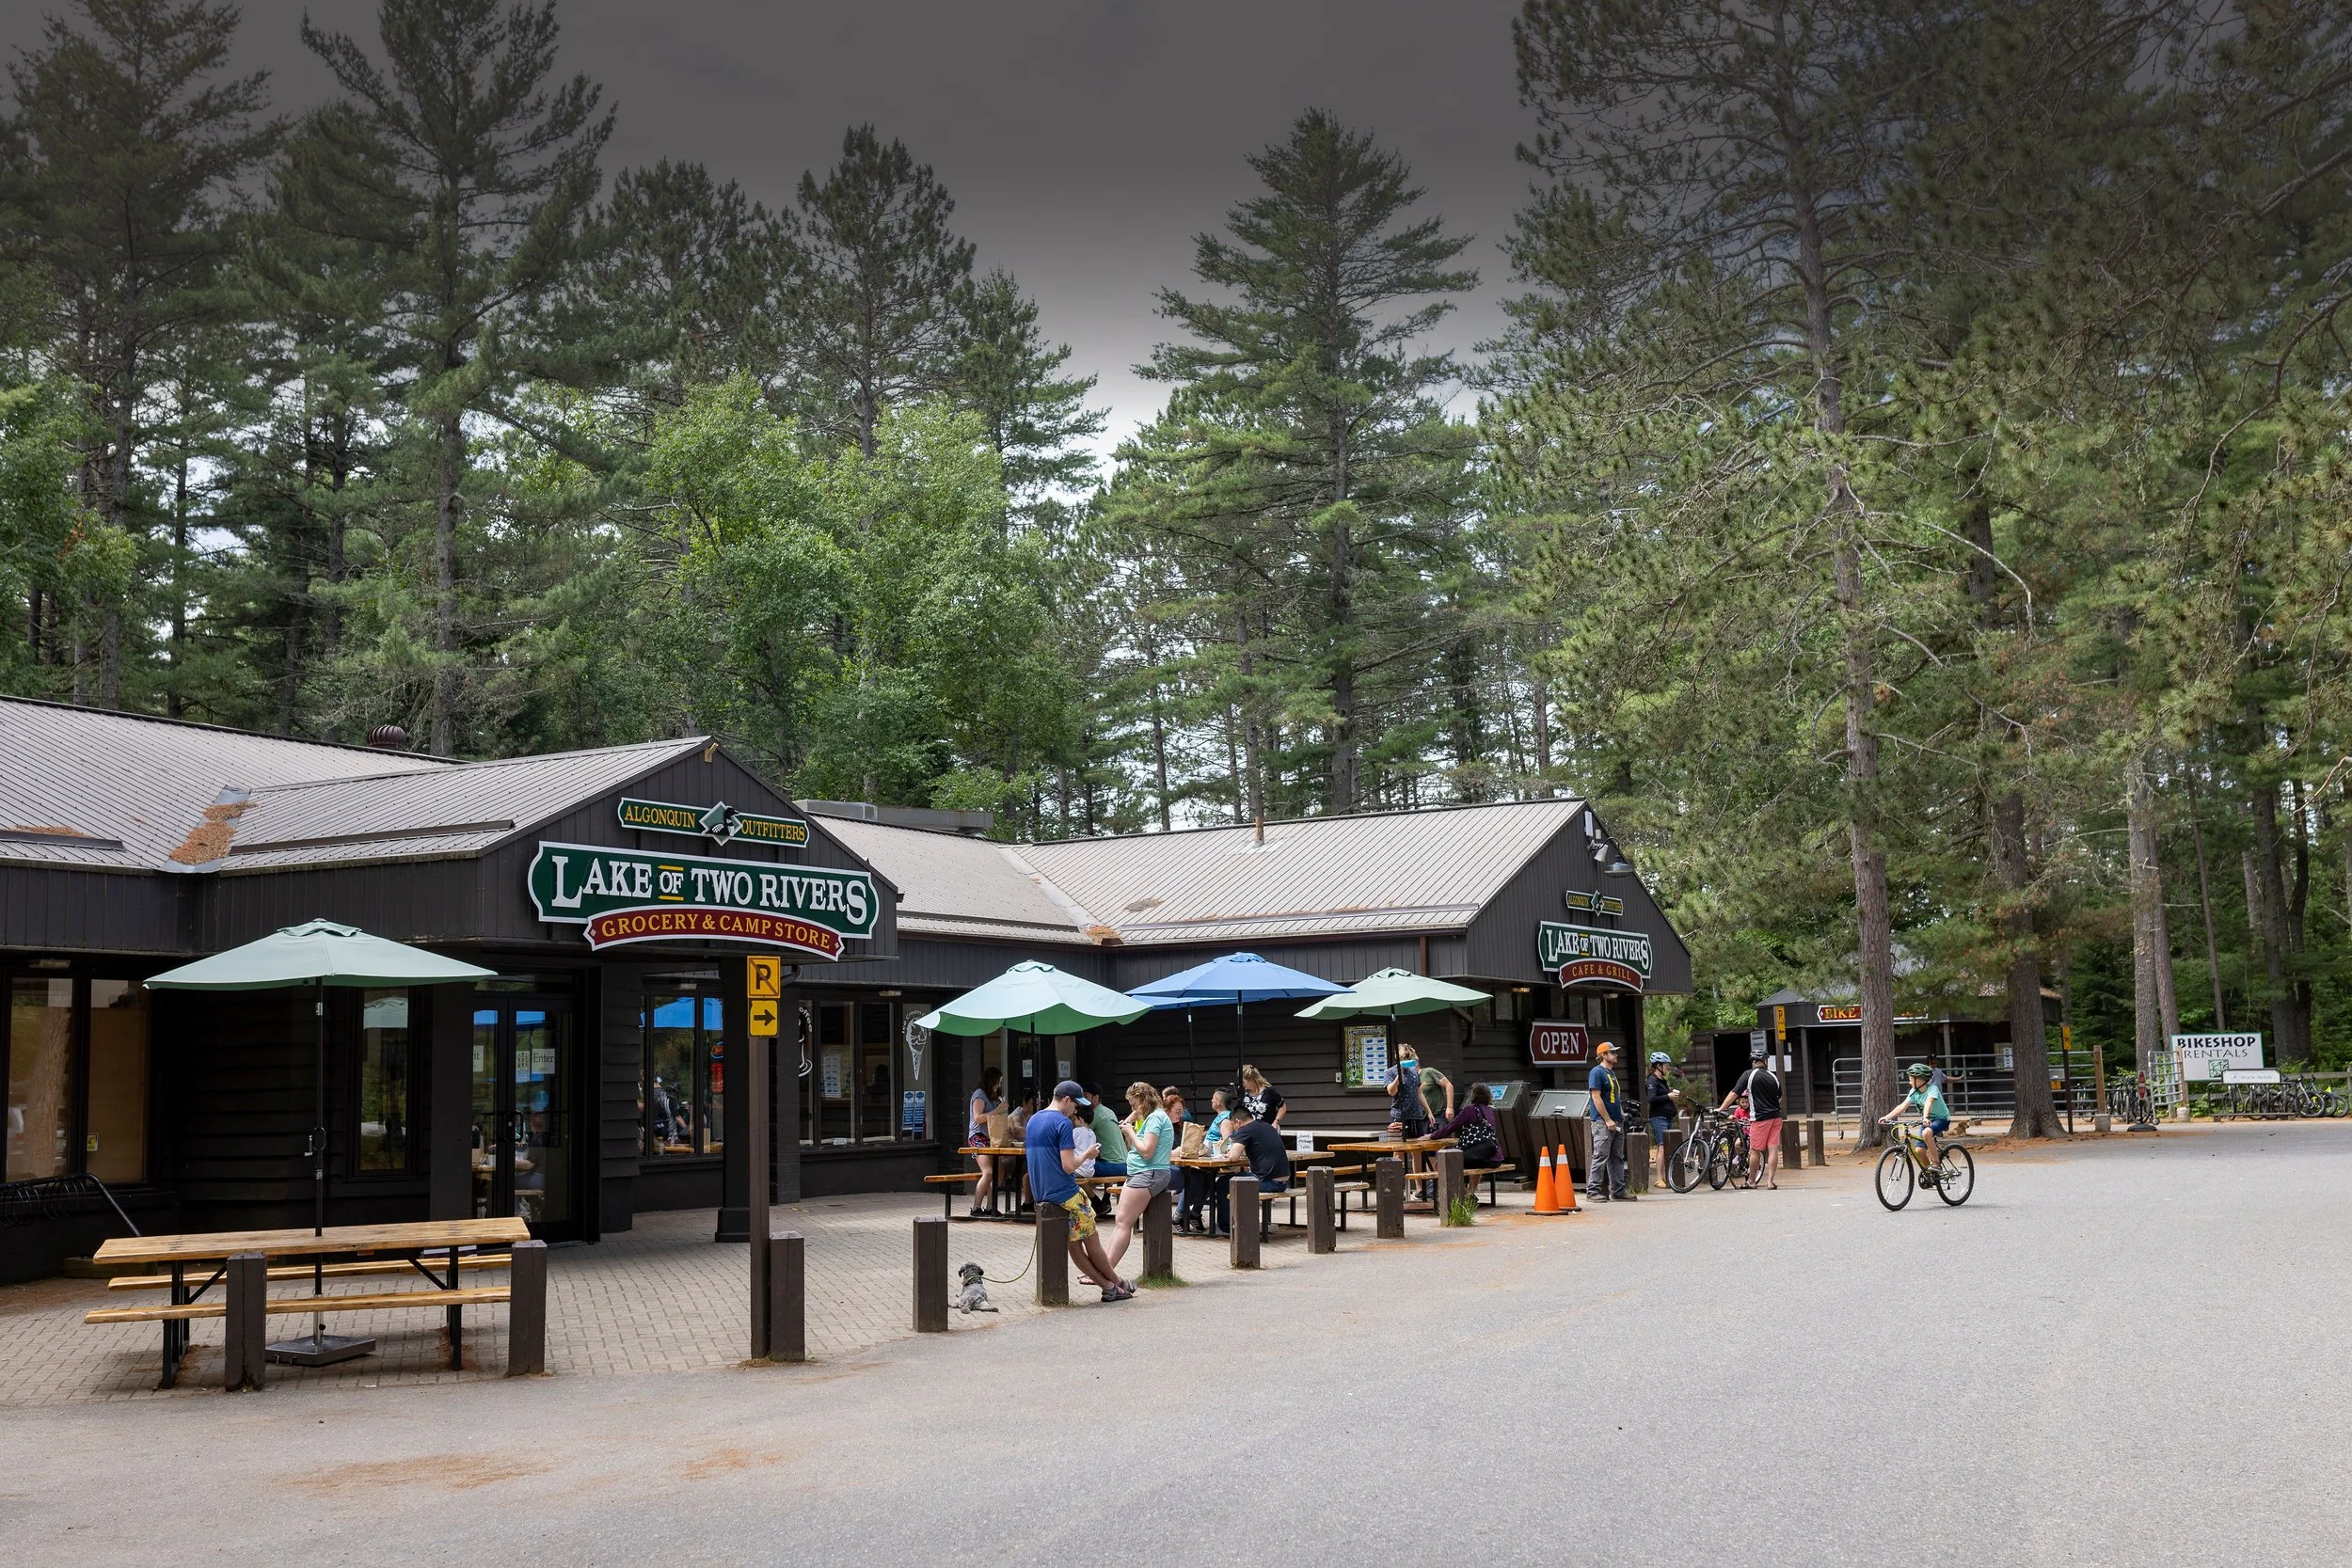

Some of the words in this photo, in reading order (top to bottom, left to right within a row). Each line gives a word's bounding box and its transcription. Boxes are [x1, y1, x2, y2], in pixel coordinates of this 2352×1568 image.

[624, 804, 696, 829] ALGONQUIN
[741, 818, 805, 841] OUTFITTERS
[551, 855, 653, 909] LAKE
[659, 871, 684, 894] OF
[691, 867, 754, 906] TWO
[759, 873, 867, 926] RIVERS
[601, 913, 698, 938] GROCERY
[702, 913, 716, 930] &
[720, 915, 771, 935] CAMP
[774, 921, 830, 950] STORE
[1546, 928, 1580, 962] LAKE
[1581, 937, 1589, 952] OF
[1590, 934, 1612, 958] TWO
[1612, 937, 1649, 970] RIVERS
[755, 963, 771, 990] P
[1572, 964, 1595, 977] CAFE
[1597, 962, 1603, 974] &
[1606, 965, 1631, 981] GRILL
[799, 1006, 813, 1033] offee
[1824, 1006, 1856, 1019] BIKE
[1540, 1031, 1580, 1054] OPEN
[2177, 1036, 2256, 1049] BIKESHOP
[2184, 1048, 2249, 1059] RENTALS
[532, 1053, 554, 1063] Enter
